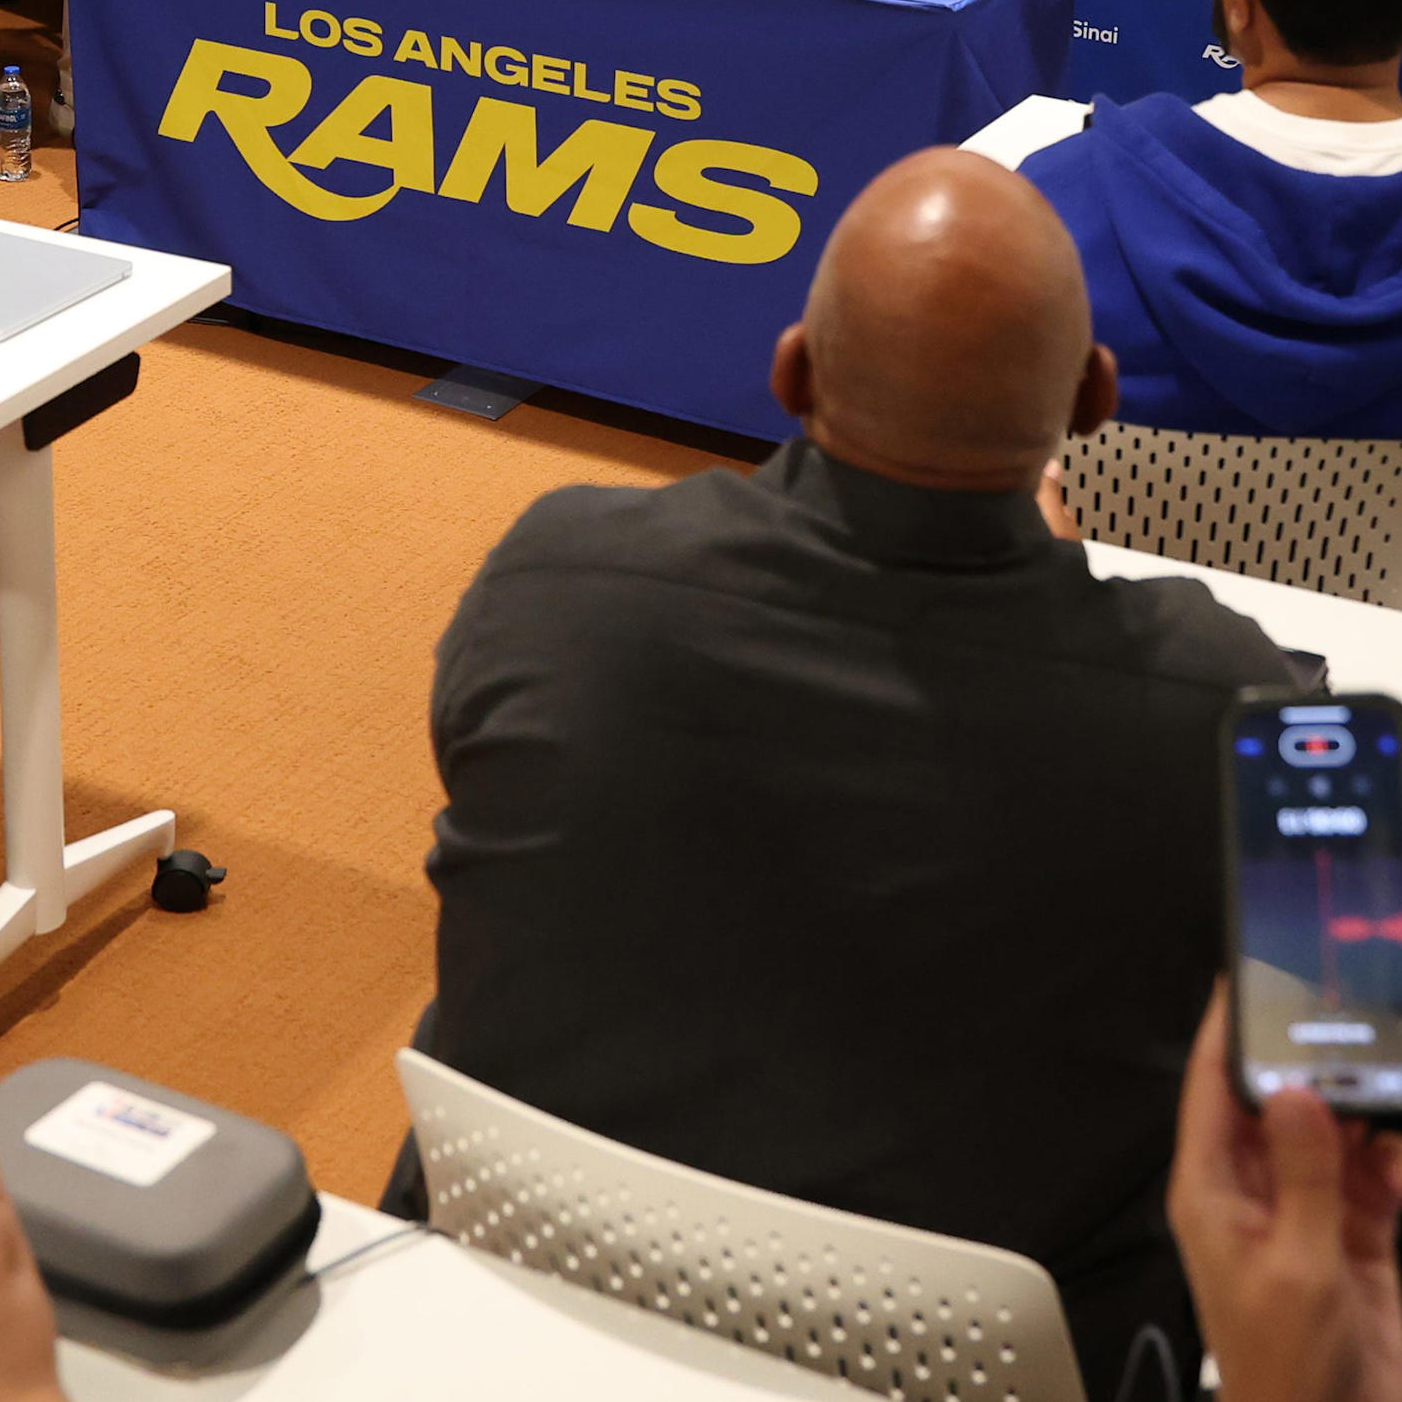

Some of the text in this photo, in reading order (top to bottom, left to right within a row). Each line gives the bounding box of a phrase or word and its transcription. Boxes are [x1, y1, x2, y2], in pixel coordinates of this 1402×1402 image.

[264, 1, 702, 121] LOS ANGELES
[1073, 19, 1119, 44] Sinai
[157, 38, 820, 265] RAMS
